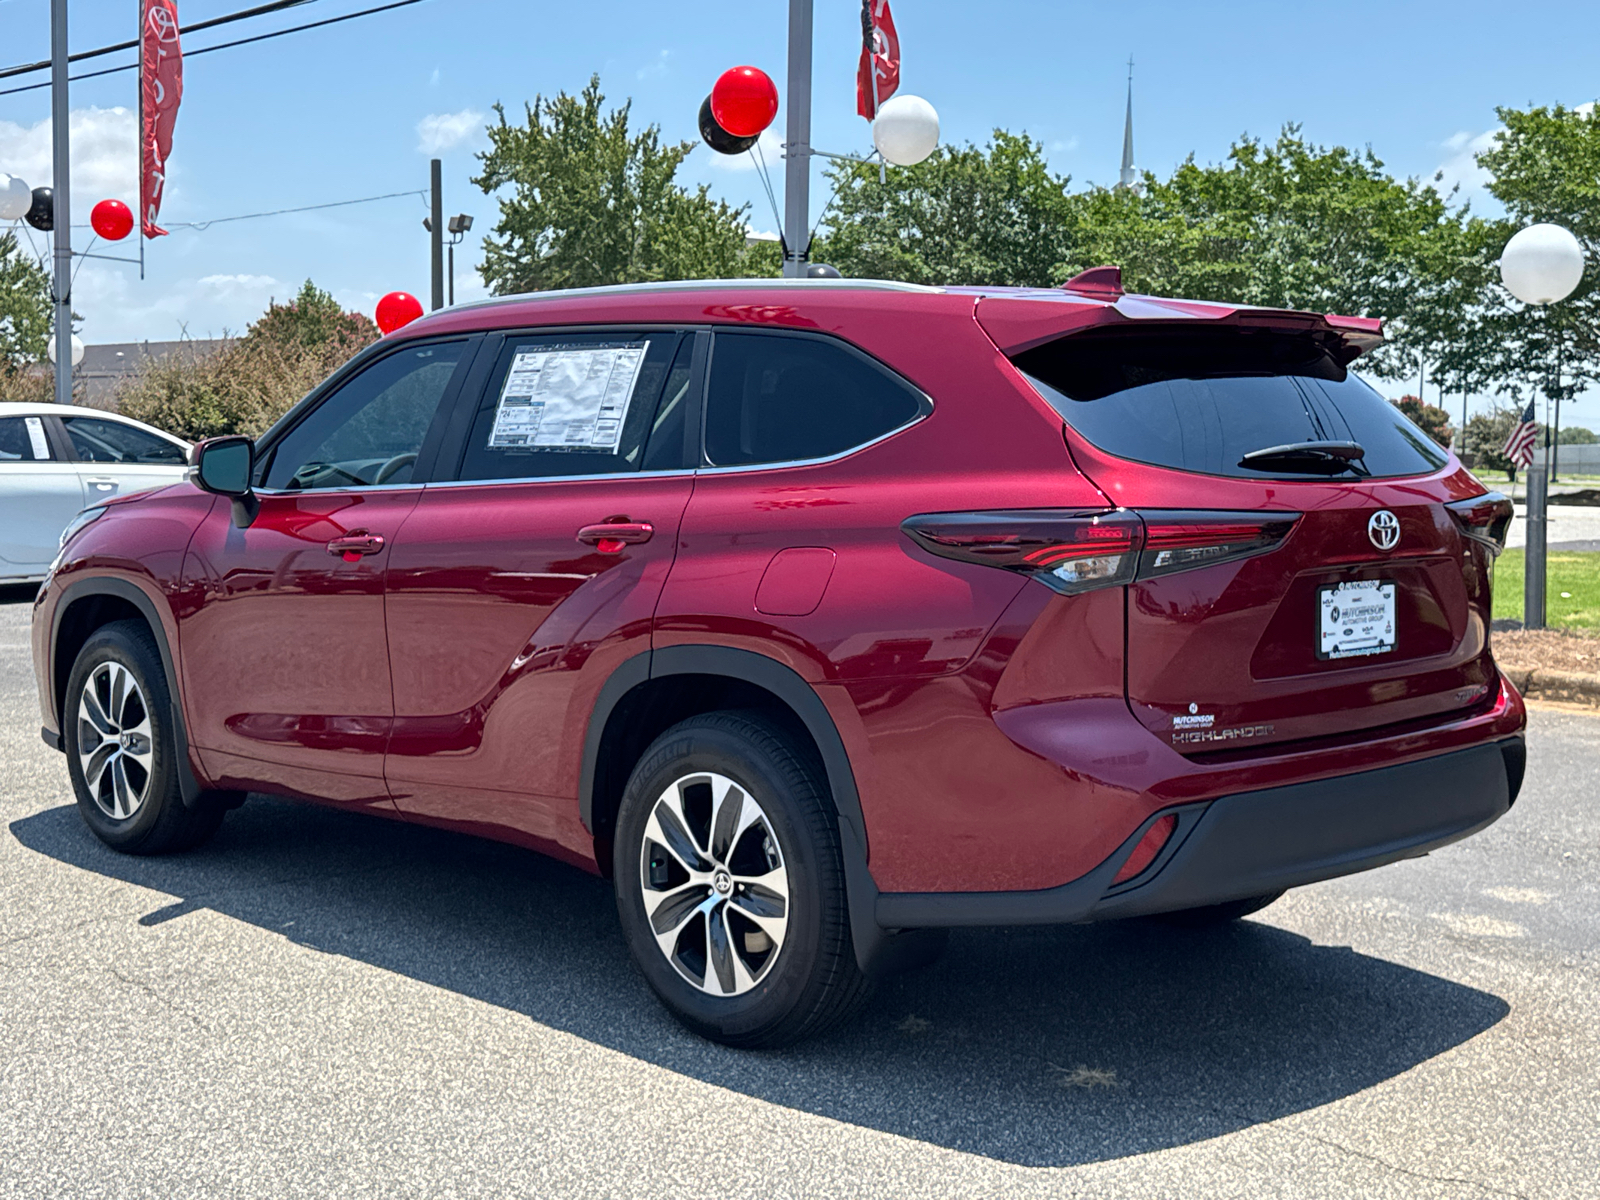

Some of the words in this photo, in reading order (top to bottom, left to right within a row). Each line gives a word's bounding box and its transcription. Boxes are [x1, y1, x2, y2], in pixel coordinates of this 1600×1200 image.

[1341, 604, 1385, 619] HUTCHINSON
[1341, 616, 1368, 626] AUTOMOTIVE
[1368, 614, 1384, 623] GROUP
[1173, 714, 1215, 725] HUTCHINSON
[1171, 725, 1276, 744] HIGHLANDER
